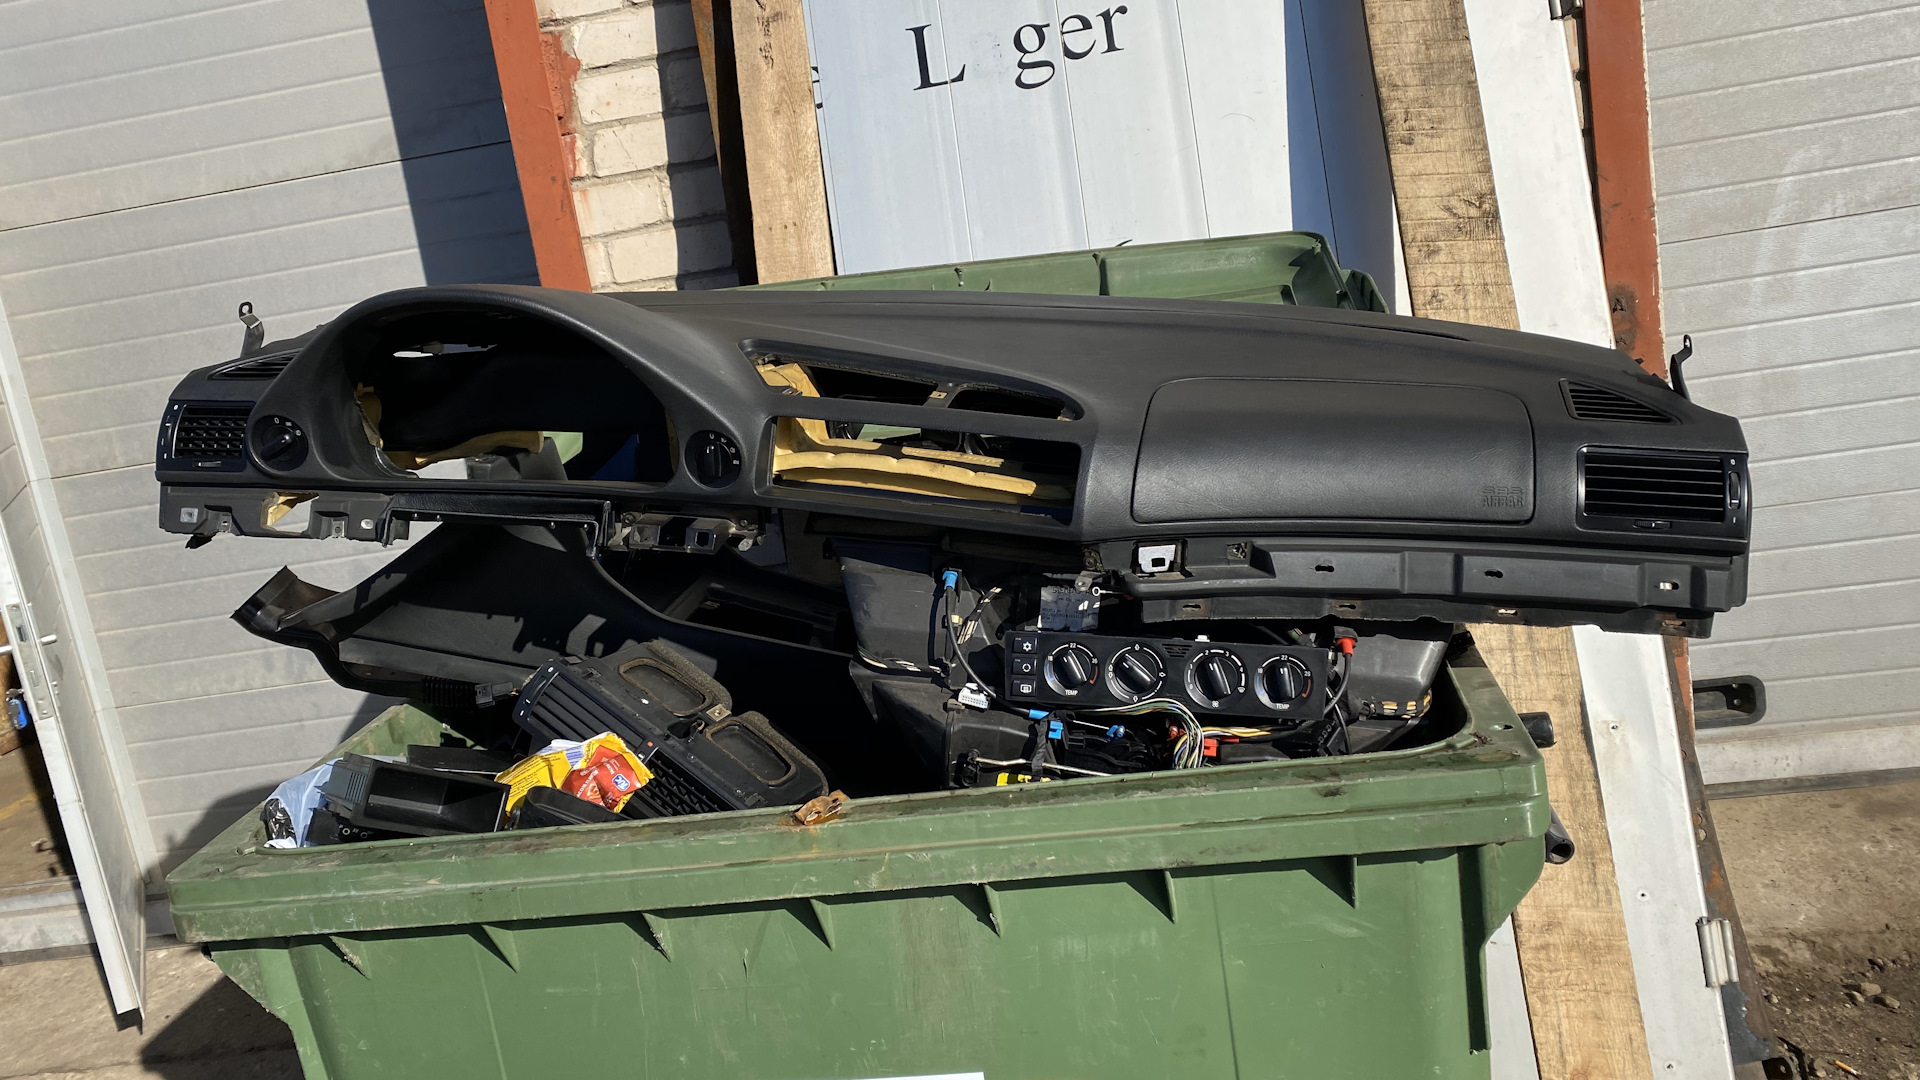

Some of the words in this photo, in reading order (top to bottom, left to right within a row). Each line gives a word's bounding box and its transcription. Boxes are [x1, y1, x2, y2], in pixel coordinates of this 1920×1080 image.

[905, 5, 1128, 90] Lger
[1482, 495, 1525, 508] AIRBAG
[613, 775, 630, 791] TUC
